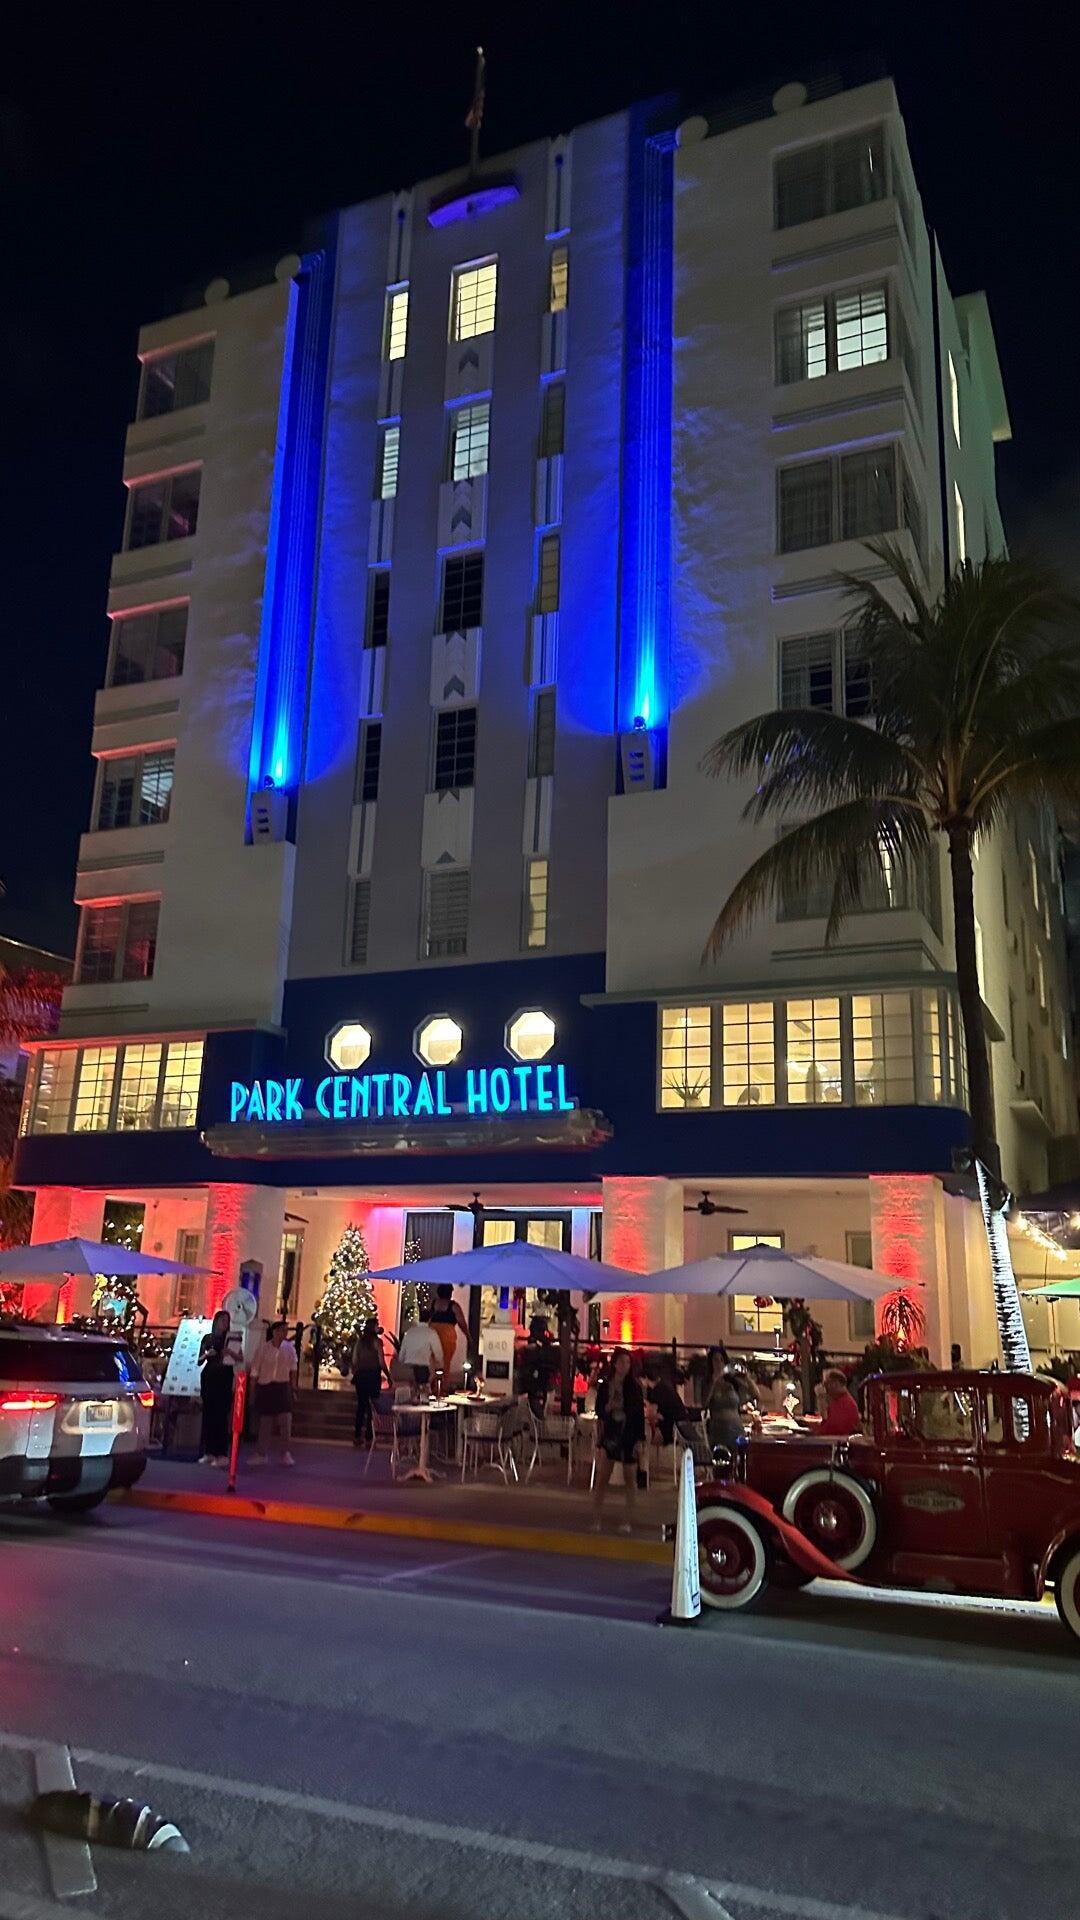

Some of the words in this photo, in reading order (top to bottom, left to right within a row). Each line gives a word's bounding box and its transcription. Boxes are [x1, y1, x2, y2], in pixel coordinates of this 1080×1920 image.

[230, 1079, 304, 1122] PARK
[315, 1071, 453, 1120] CENTRAL
[466, 1064, 575, 1114] HOTEL
